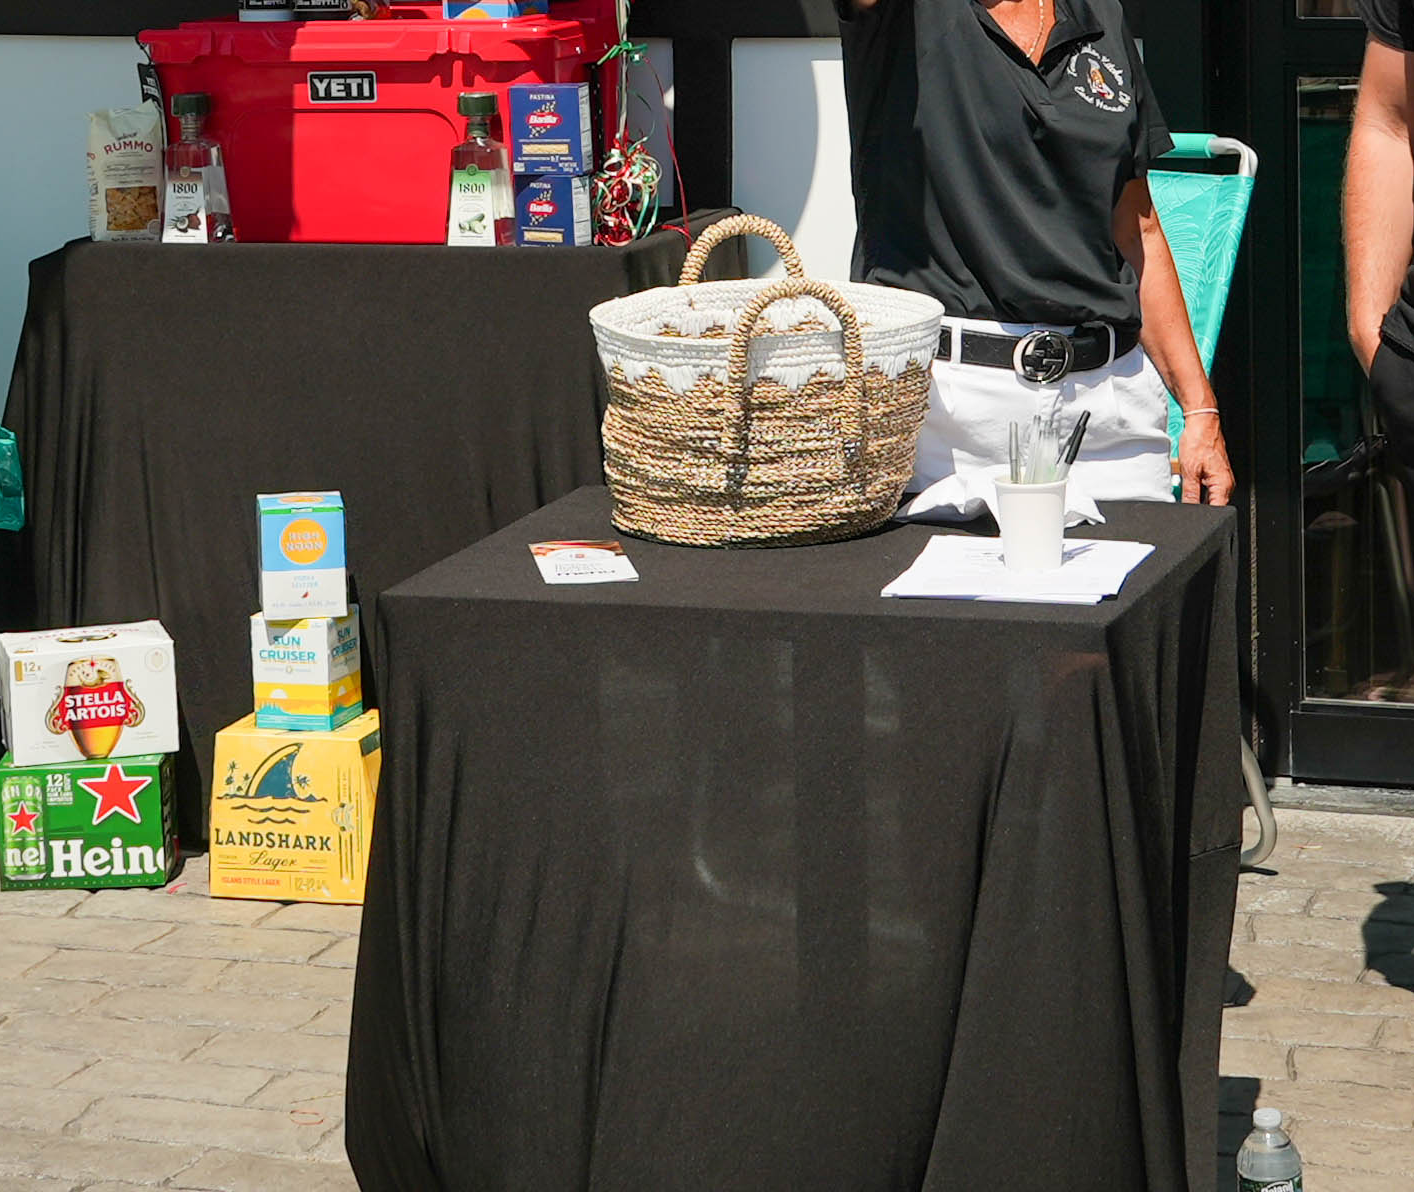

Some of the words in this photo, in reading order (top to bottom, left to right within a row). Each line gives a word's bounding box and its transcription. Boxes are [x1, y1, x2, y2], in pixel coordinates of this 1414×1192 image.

[312, 78, 370, 97] YETI
[529, 93, 555, 101] PASTINA
[528, 114, 558, 126] Barilla
[103, 140, 154, 155] RUMMO
[172, 183, 198, 194] 1800
[459, 182, 485, 194] 1800
[273, 635, 302, 647] SUN
[259, 649, 316, 662] CRUISER
[64, 691, 126, 709] STELLA
[64, 704, 127, 722] ARTOIS
[46, 773, 64, 786] 12
[214, 828, 332, 852] LANDSHARK
[249, 850, 299, 872] Lager
